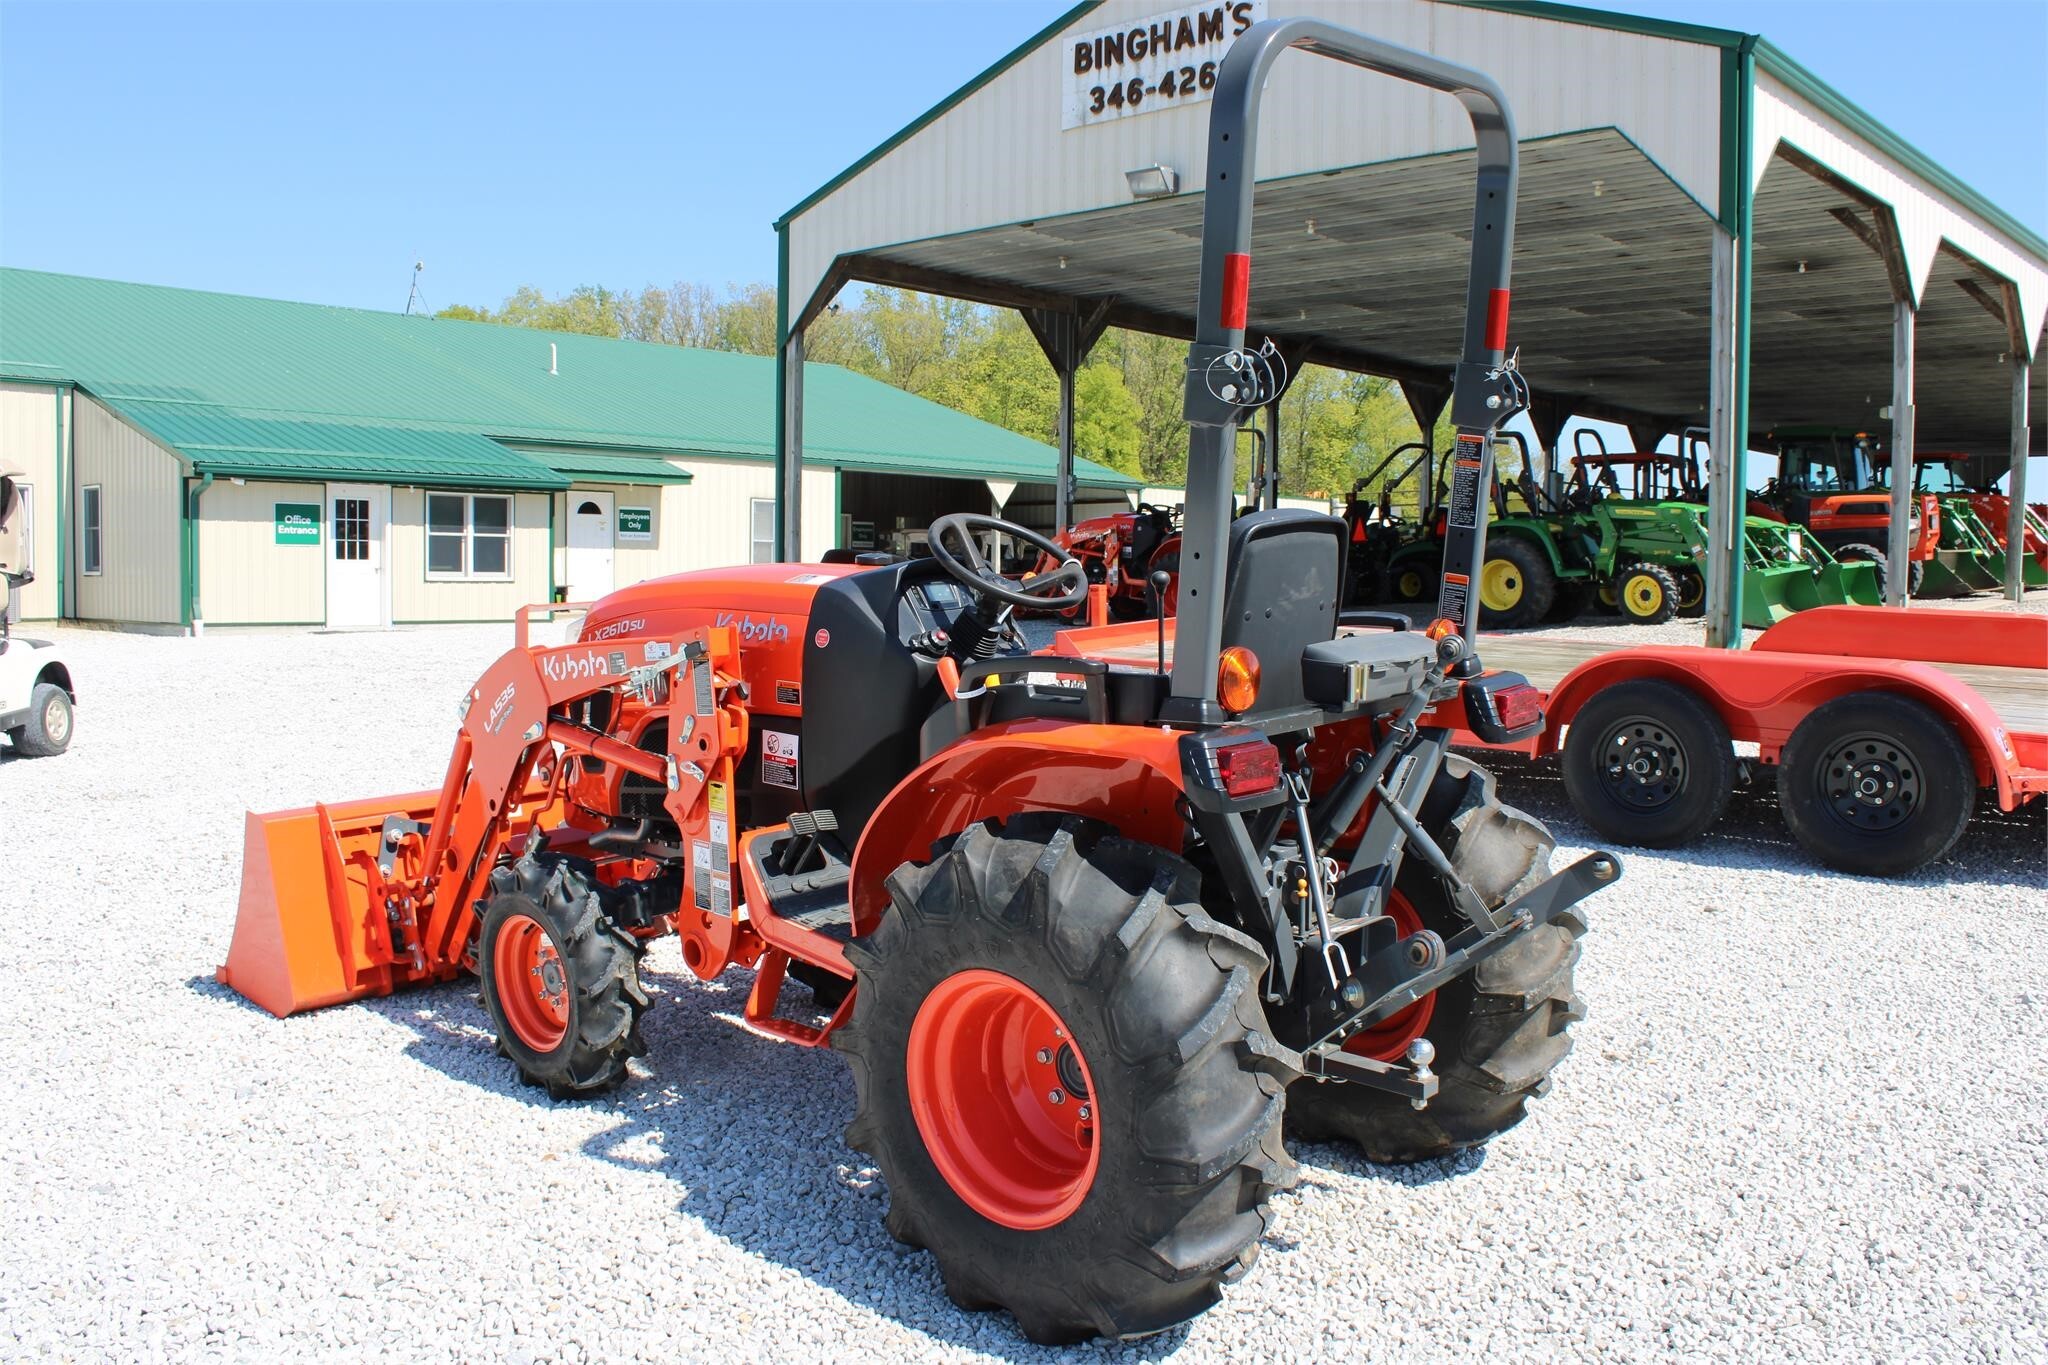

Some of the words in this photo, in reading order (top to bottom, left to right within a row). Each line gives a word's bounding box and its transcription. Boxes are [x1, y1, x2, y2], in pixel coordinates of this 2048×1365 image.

[1074, 1, 1253, 75] BINGHAM'S
[1089, 59, 1219, 115] 346-426
[285, 514, 311, 524] Office
[620, 512, 650, 521] Employees
[628, 521, 641, 530] Only
[278, 525, 318, 535] Entrance
[543, 650, 608, 681] Kubota
[484, 681, 515, 733] LA535
